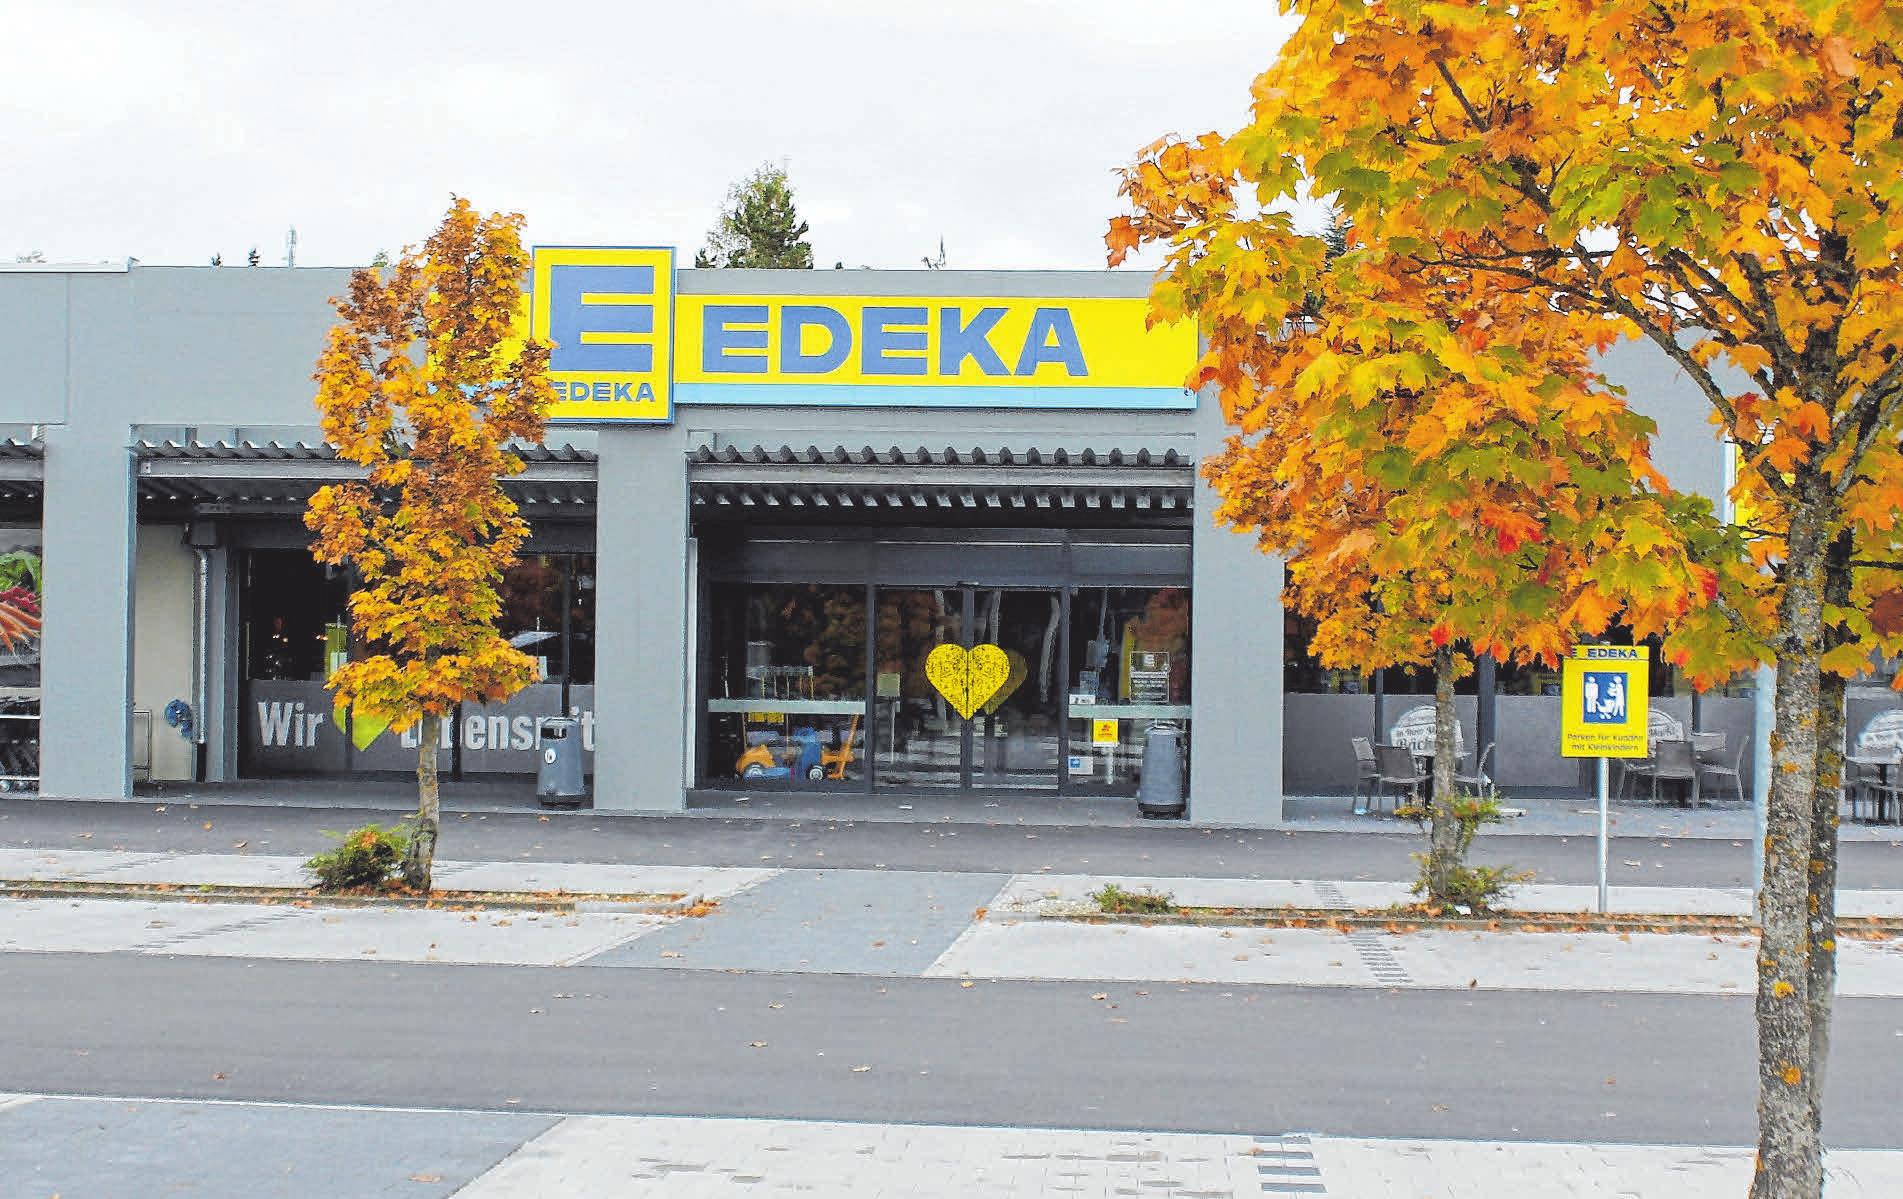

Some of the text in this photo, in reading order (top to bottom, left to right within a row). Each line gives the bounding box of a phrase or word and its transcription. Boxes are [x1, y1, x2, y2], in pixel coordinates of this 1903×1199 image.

[550, 265, 654, 372] E
[702, 304, 1089, 377] EDEKA
[552, 381, 656, 402] EDEKA
[1587, 648, 1638, 658] EDEKA
[257, 701, 594, 751] Wir Lbenst
